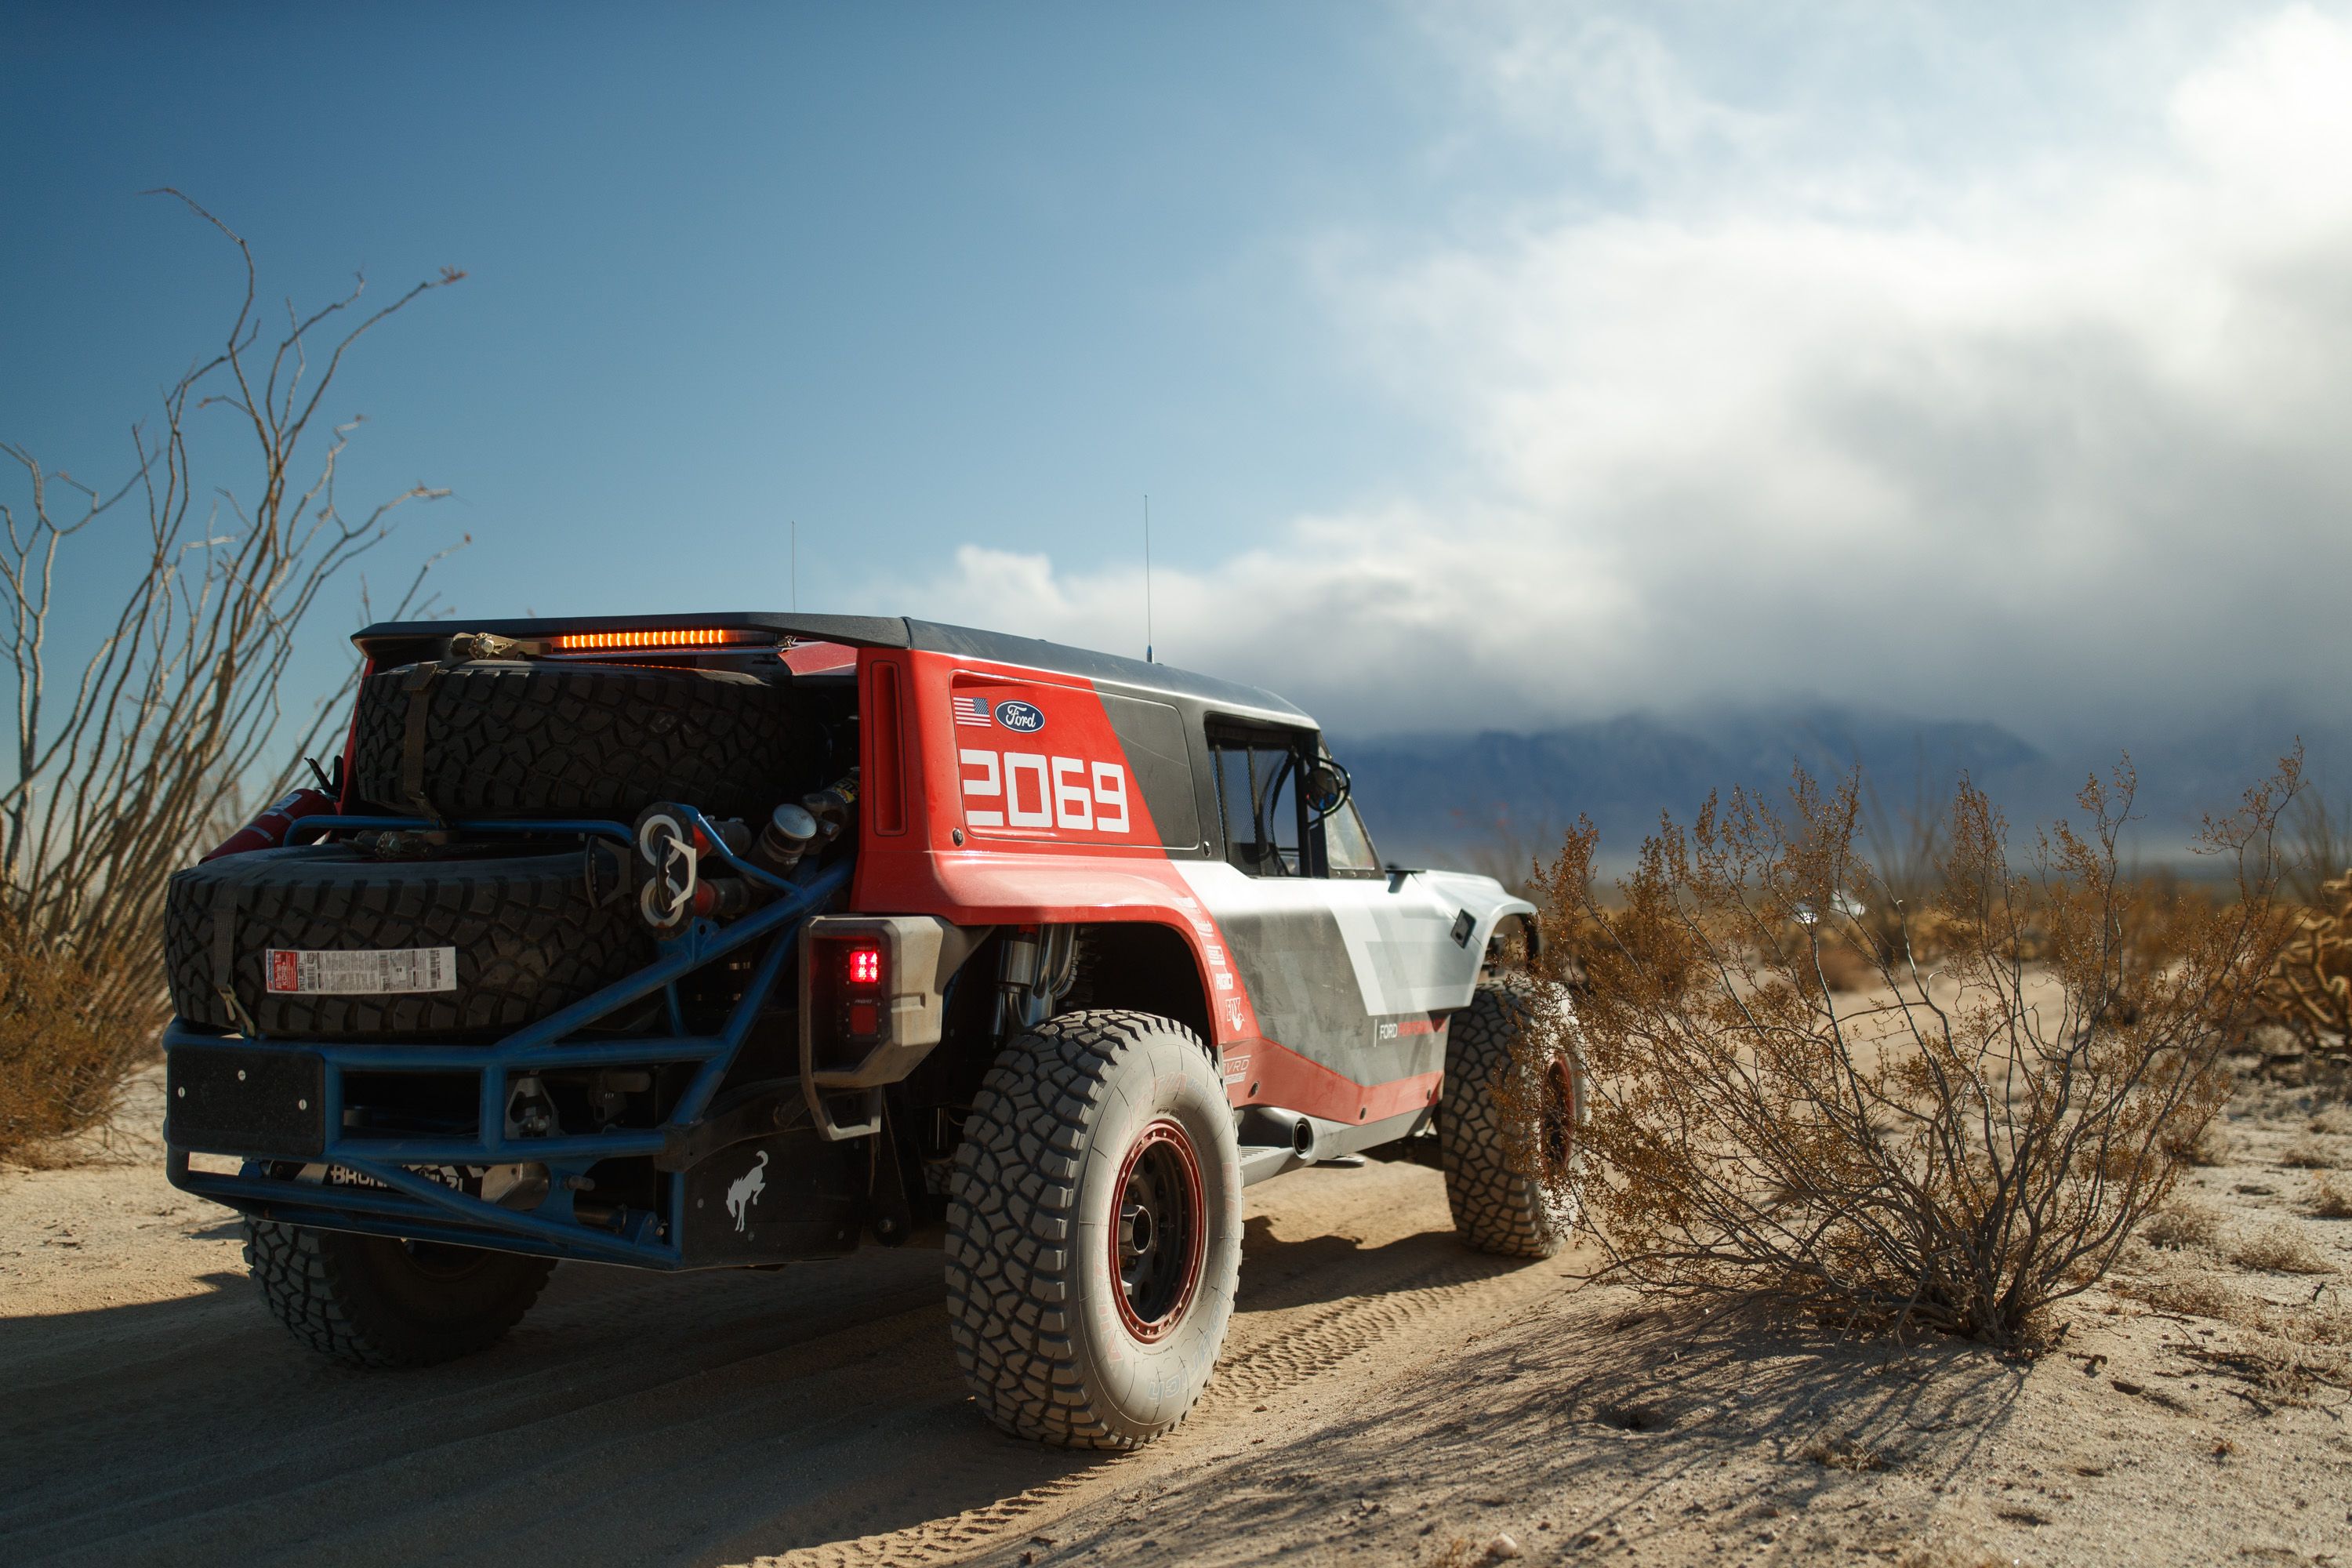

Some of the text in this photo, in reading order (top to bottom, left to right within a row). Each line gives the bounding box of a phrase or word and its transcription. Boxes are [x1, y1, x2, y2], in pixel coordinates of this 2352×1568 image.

[1005, 703, 1037, 728] Ford
[959, 748, 1131, 833] 2069
[1225, 997, 1242, 1022] FOX
[1379, 1023, 1398, 1040] FORD
